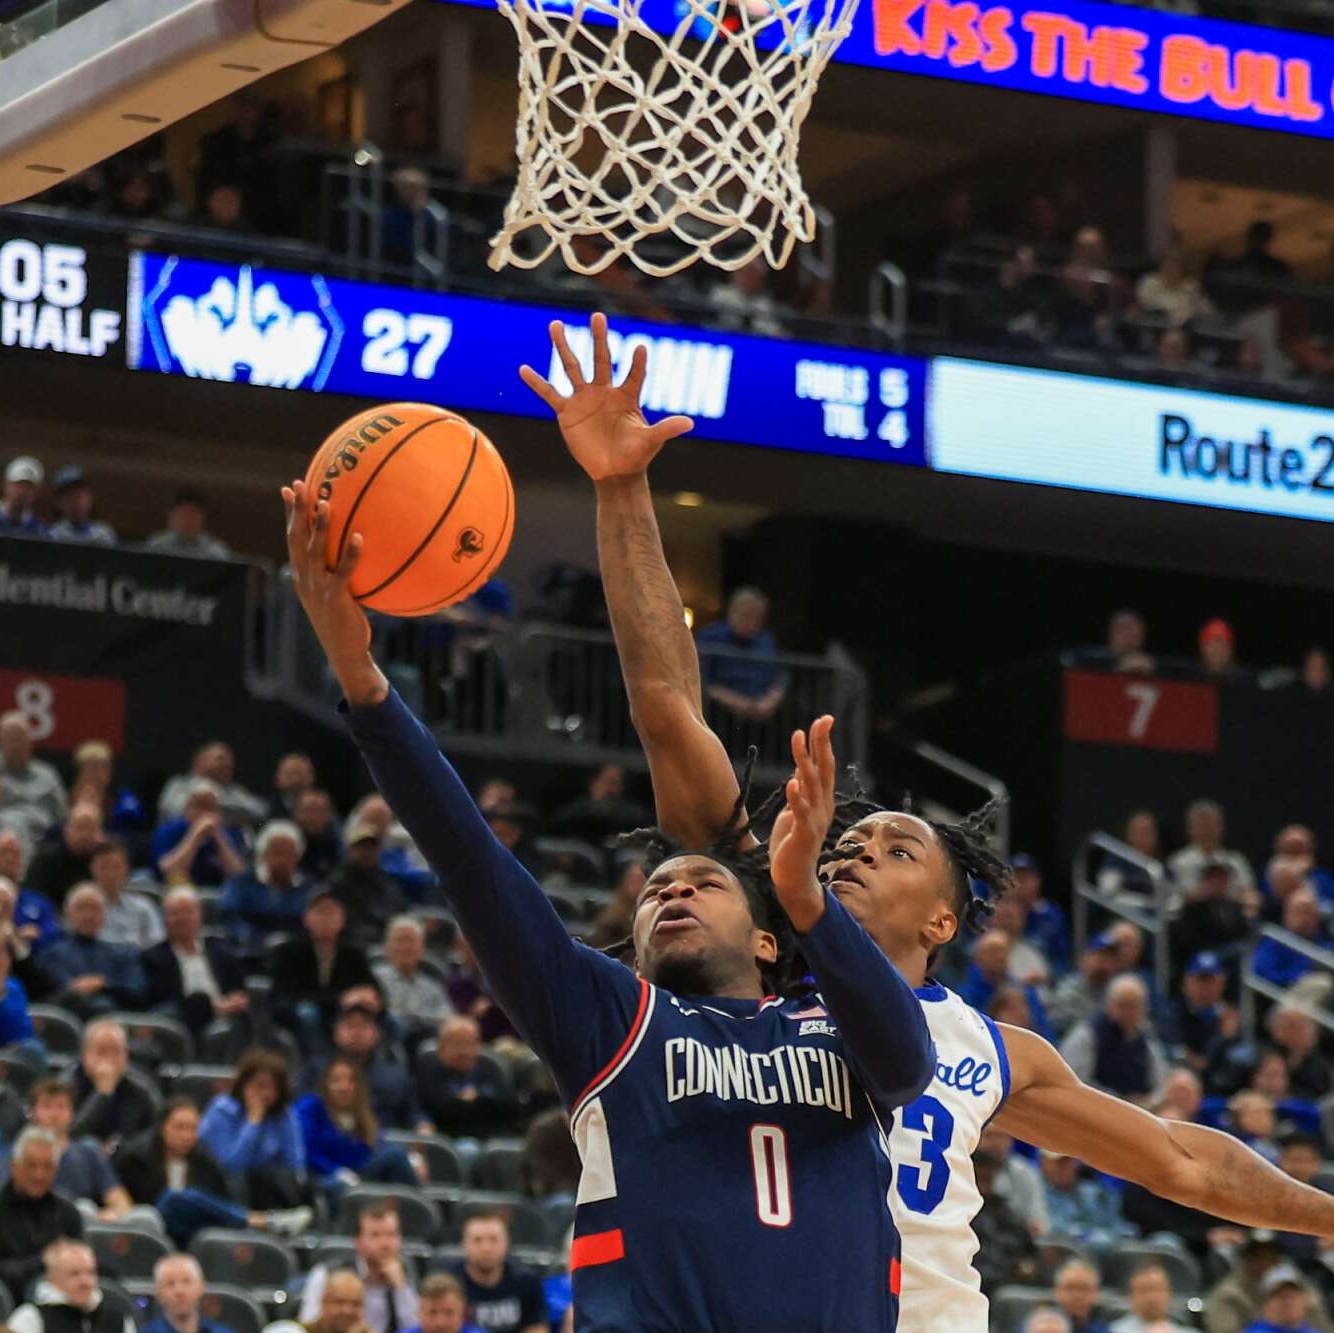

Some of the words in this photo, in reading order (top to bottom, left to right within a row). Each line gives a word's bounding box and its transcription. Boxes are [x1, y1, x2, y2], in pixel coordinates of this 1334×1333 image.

[871, 0, 1018, 72] KISS
[1022, 11, 1150, 95] THE
[1160, 35, 1323, 121] BULL
[0, 298, 122, 360] HALF
[360, 308, 454, 381] 27
[877, 409, 910, 449] 4
[111, 579, 217, 626] Center
[14, 679, 55, 741] 8
[1124, 684, 1159, 738] 7
[749, 1122, 793, 1229] 0
